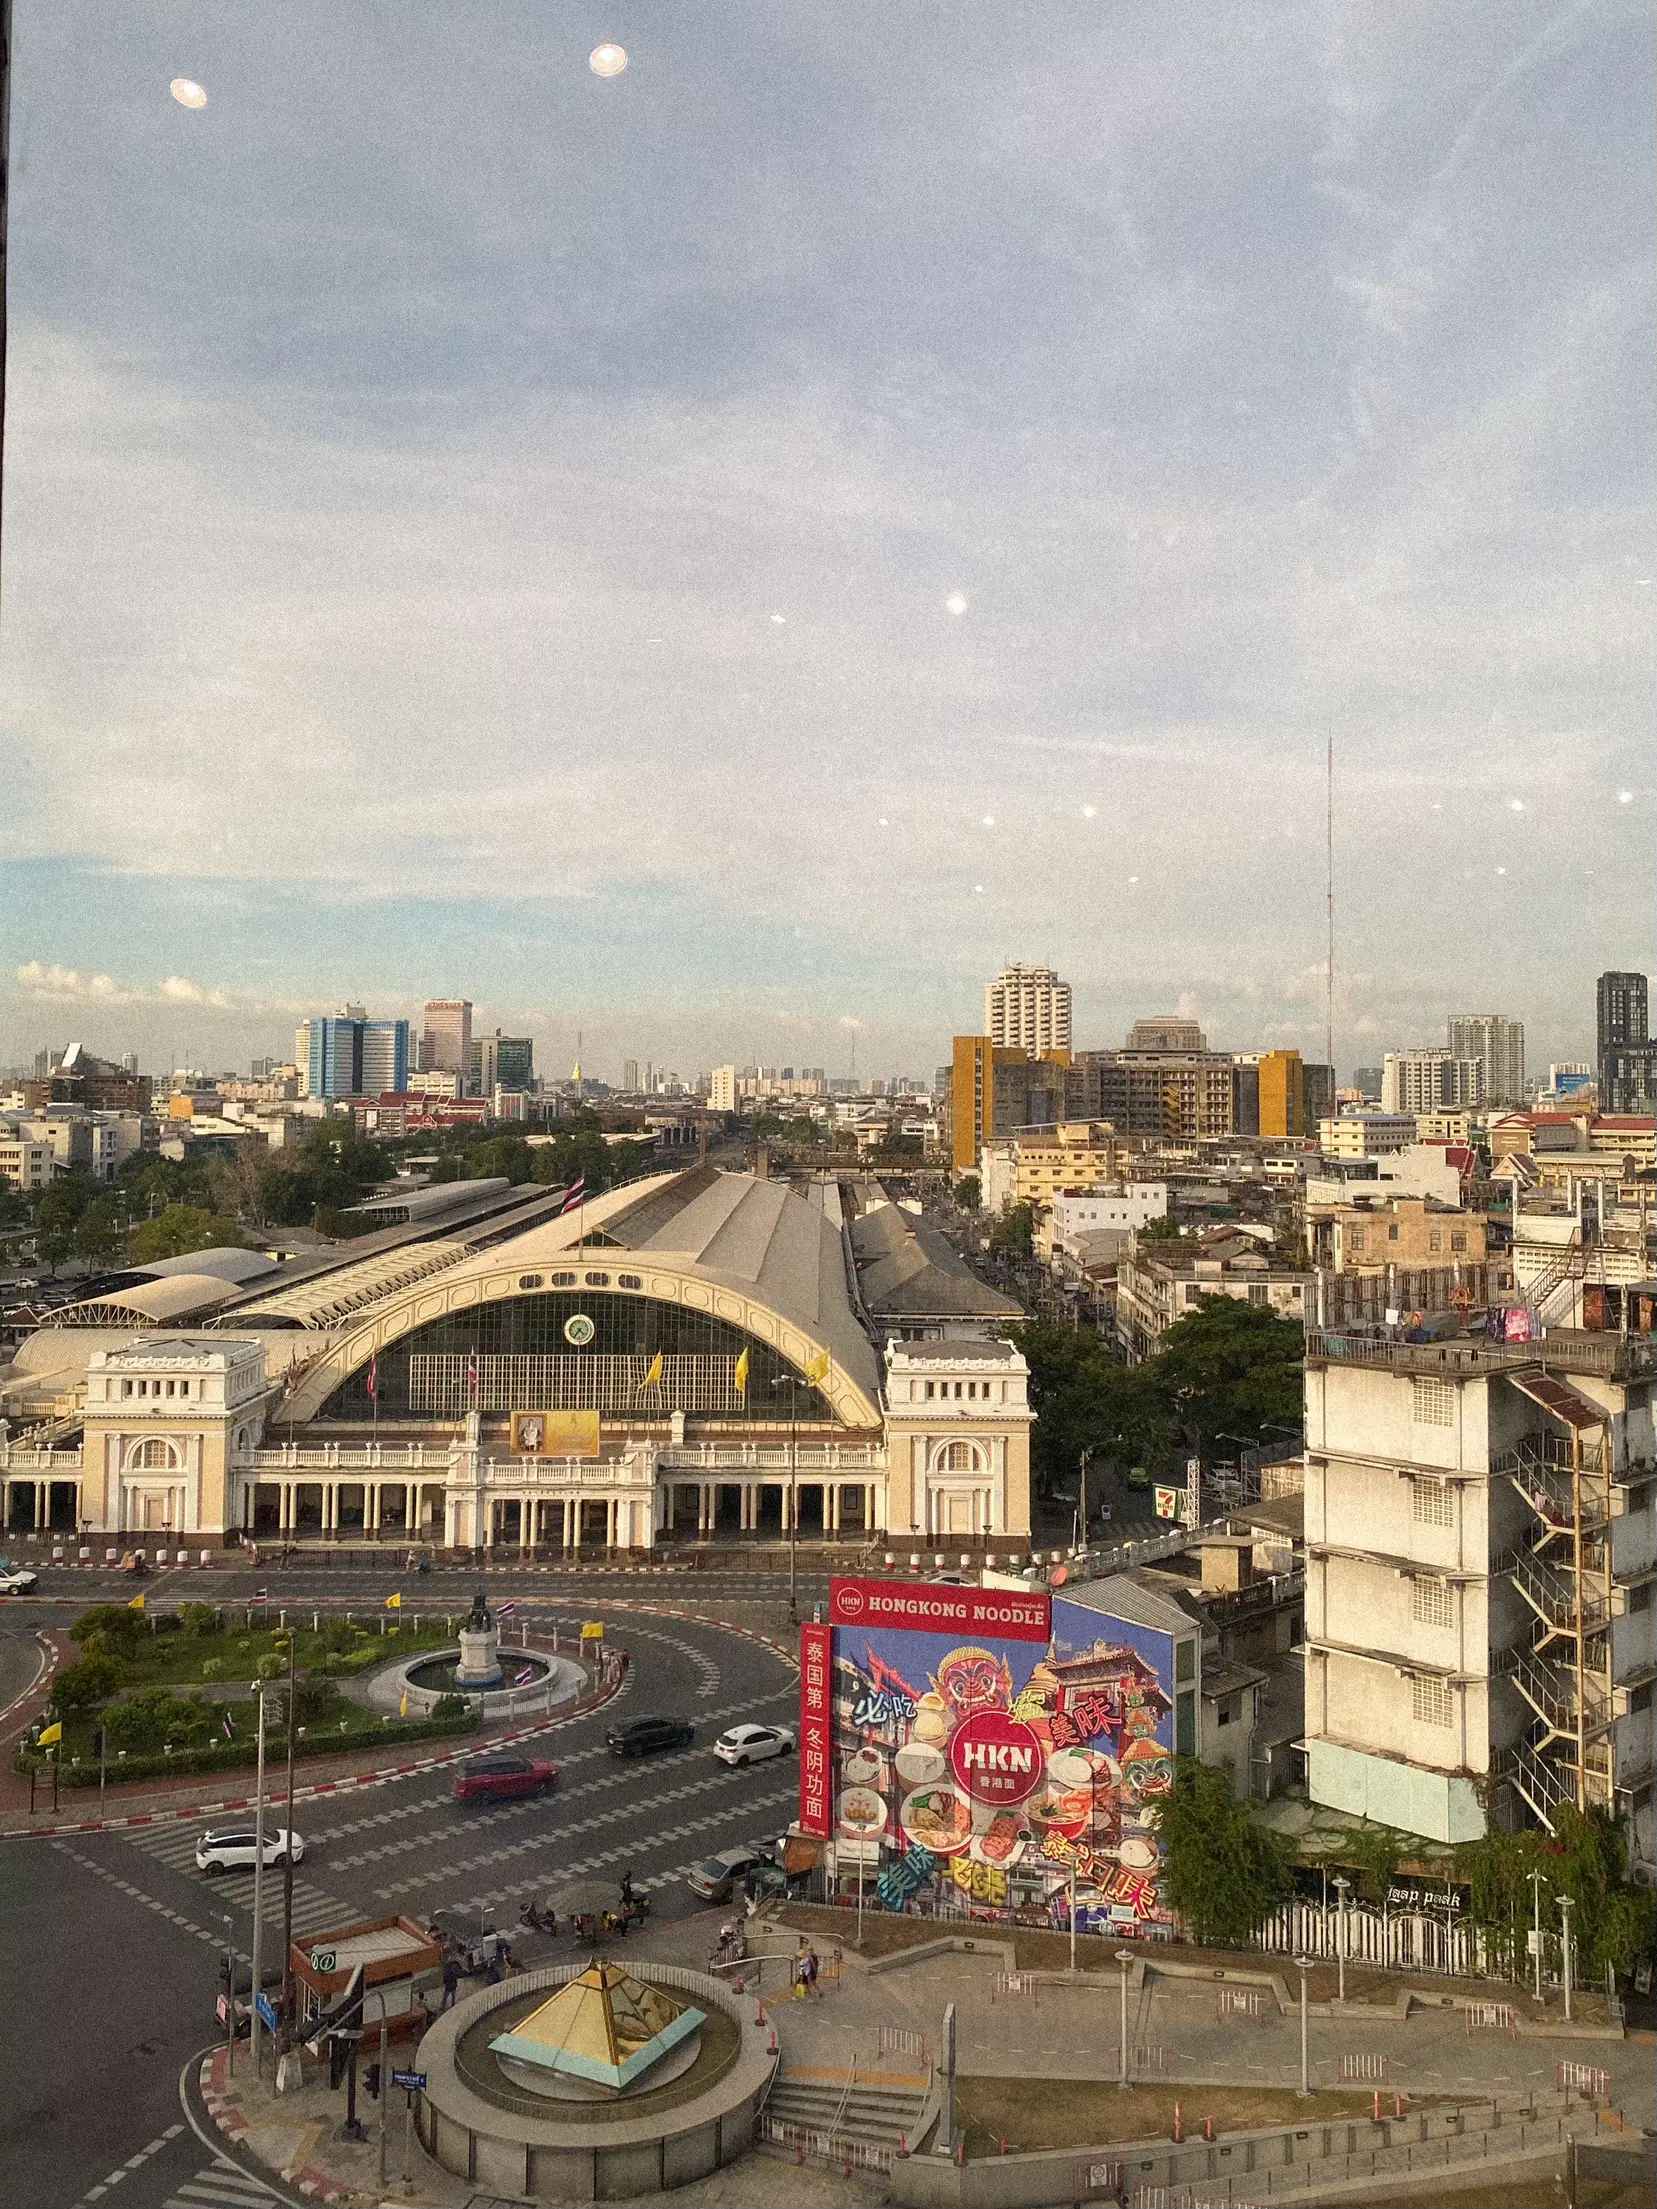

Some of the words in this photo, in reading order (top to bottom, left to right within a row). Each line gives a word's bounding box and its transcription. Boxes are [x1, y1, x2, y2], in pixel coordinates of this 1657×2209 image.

[841, 1597, 860, 1606] HKN
[869, 1596, 967, 1618] HONGKONG
[973, 1606, 1045, 1625] NOODLE
[806, 1642, 824, 1819] 泰国第一冬阴功面
[1051, 1697, 1122, 1747] 美味
[964, 1743, 1033, 1773] HKN
